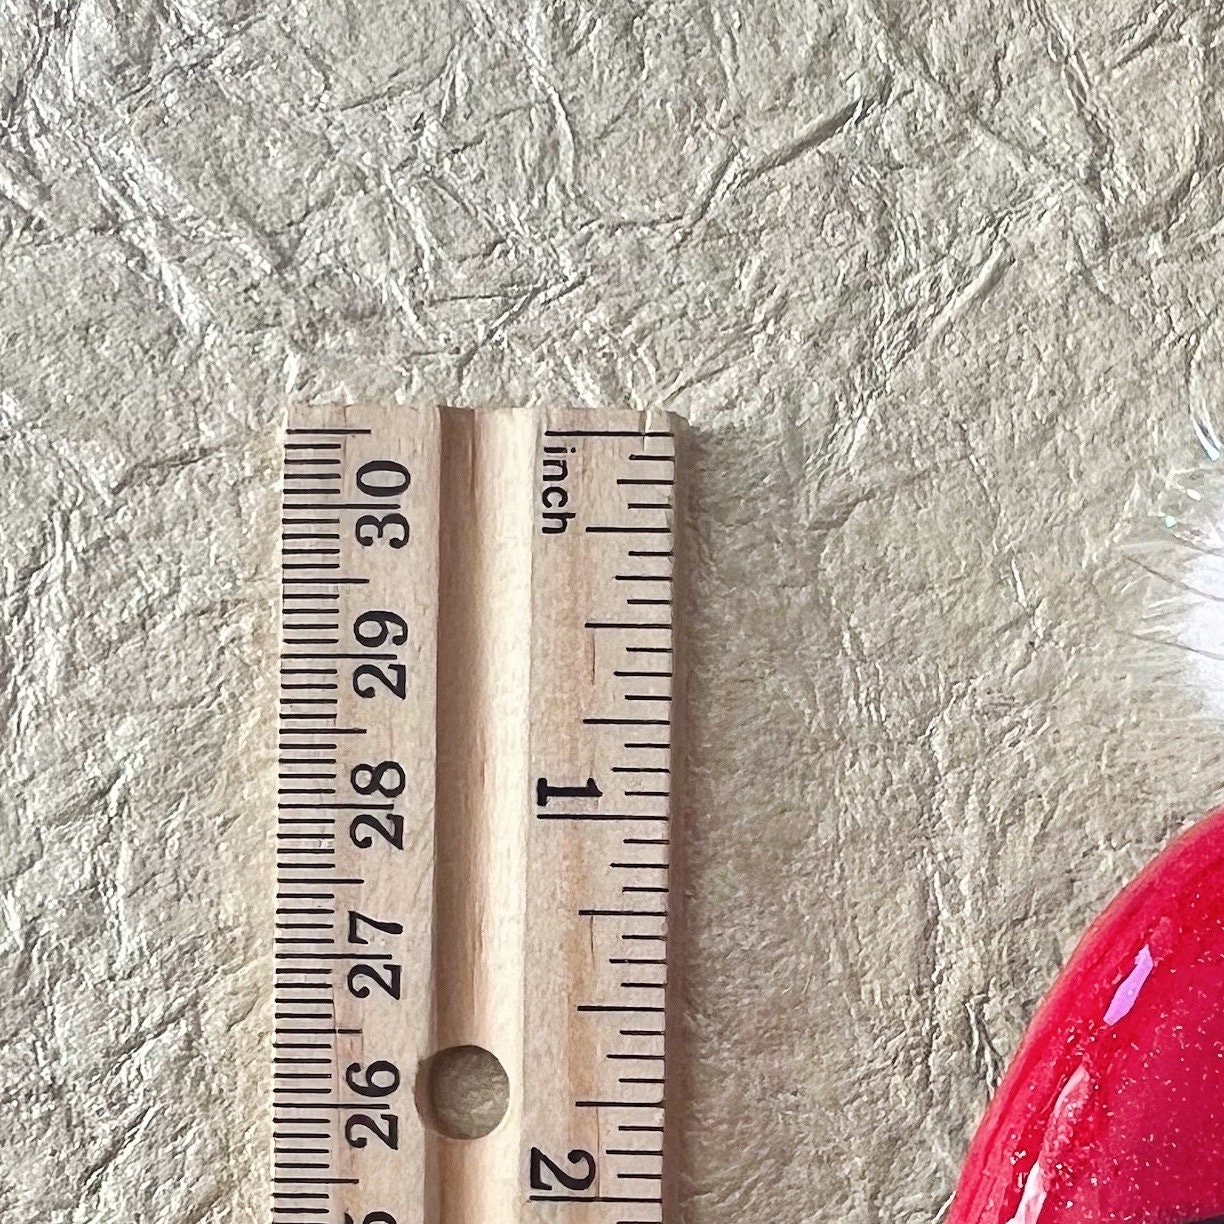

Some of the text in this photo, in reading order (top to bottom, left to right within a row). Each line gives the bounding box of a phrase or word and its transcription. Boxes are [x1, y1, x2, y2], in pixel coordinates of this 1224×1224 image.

[355, 460, 410, 549] 30
[541, 446, 576, 534] inch
[353, 611, 408, 699] 29
[350, 761, 405, 850] 28
[537, 777, 602, 806] 1
[348, 910, 403, 1000] 27
[345, 1060, 400, 1150] 26
[530, 1147, 596, 1192] 2
